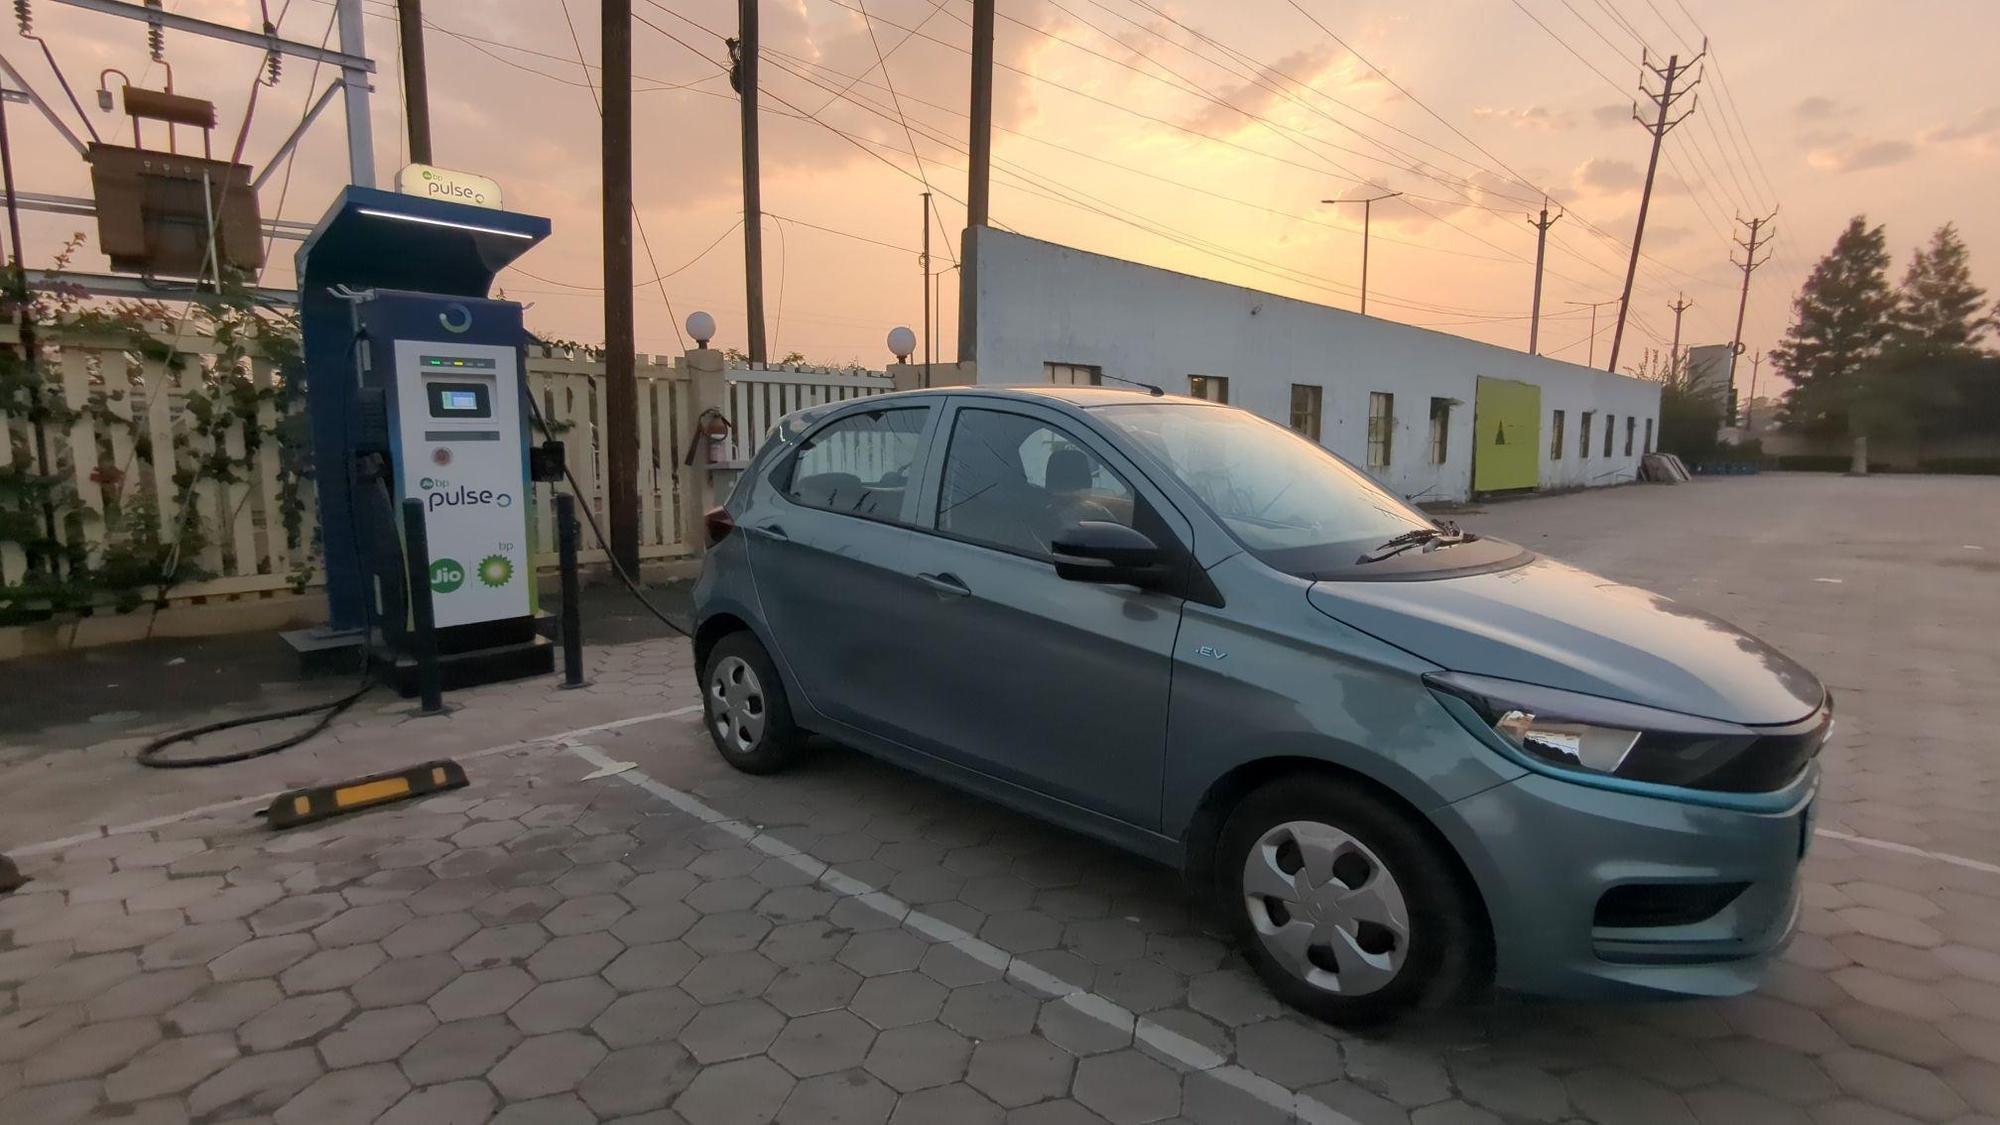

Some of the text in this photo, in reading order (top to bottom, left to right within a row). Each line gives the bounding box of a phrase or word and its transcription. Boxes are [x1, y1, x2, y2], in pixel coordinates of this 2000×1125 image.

[429, 181, 473, 199] pulse
[429, 485, 493, 512] pulse
[498, 541, 514, 551] bp
[431, 567, 461, 584] Jio
